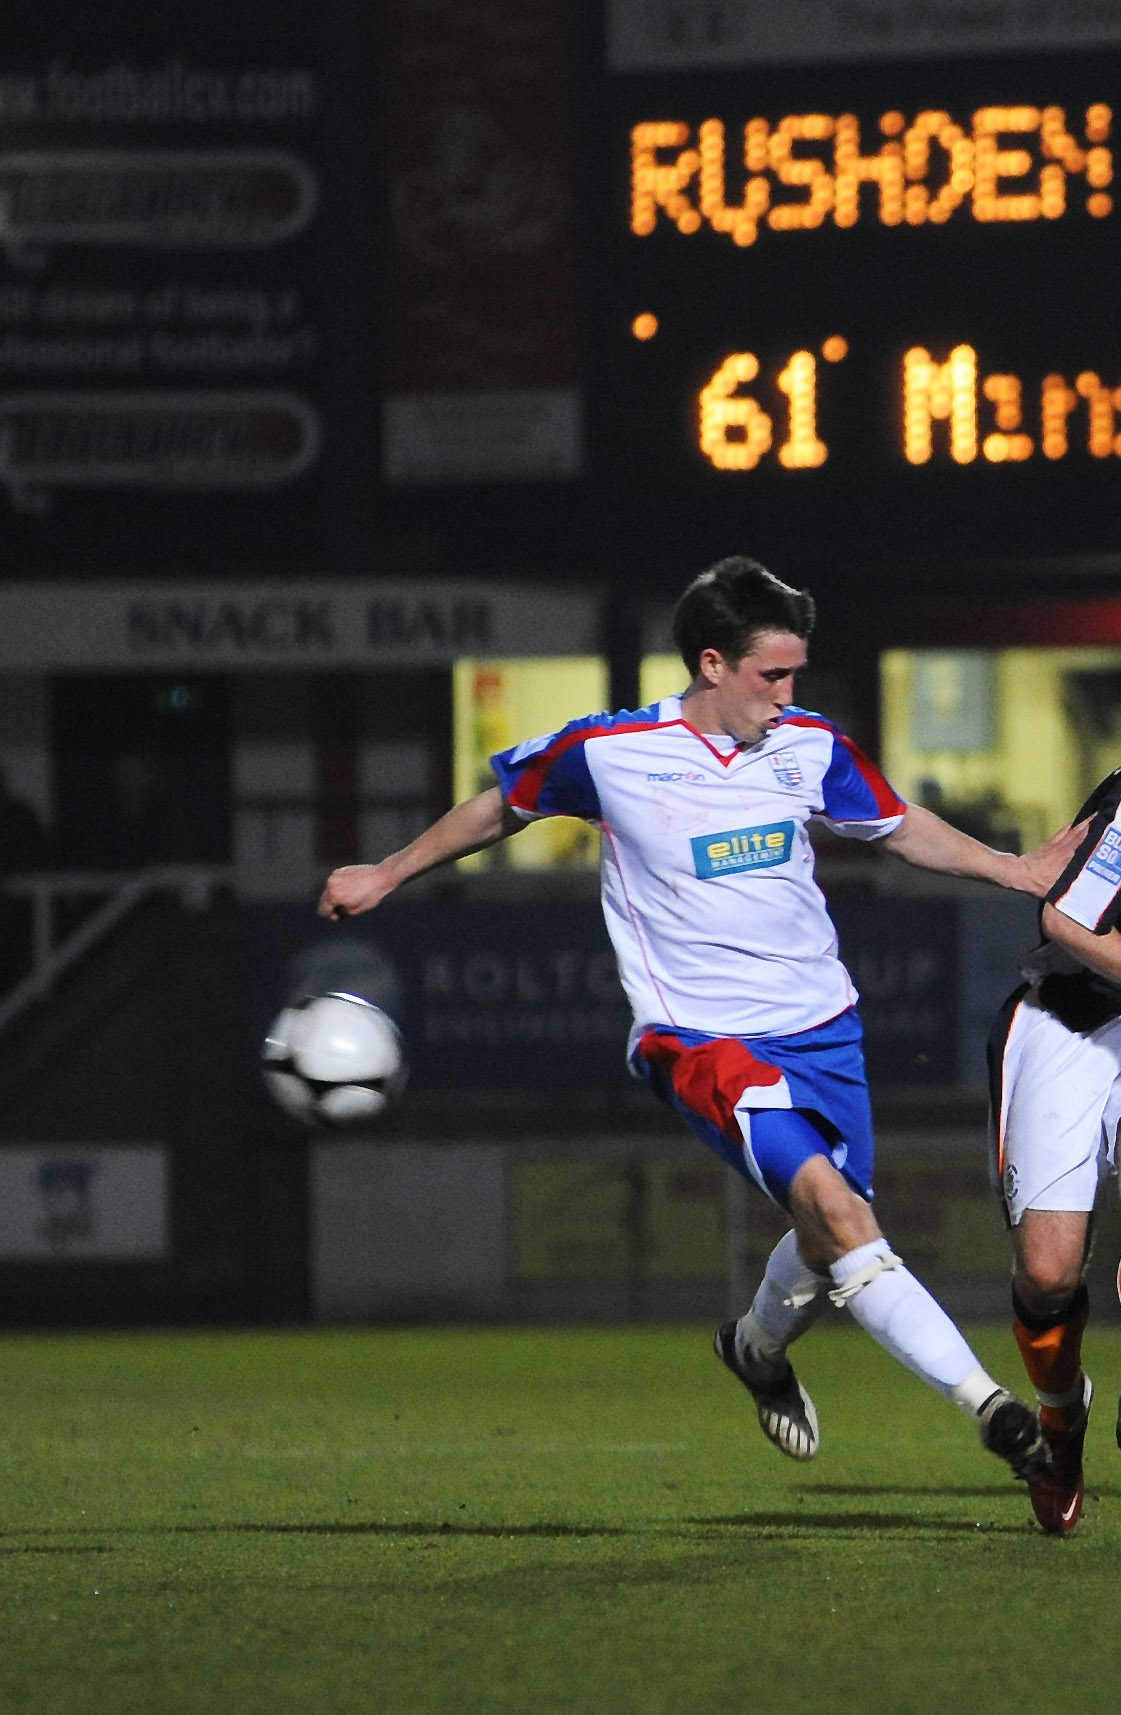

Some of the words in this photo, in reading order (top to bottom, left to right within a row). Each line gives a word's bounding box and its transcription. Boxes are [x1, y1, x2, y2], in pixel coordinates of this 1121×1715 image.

[631, 104, 1113, 247] RUSHDEN
[698, 350, 829, 471] 61
[126, 597, 334, 652] SNACK
[366, 597, 496, 651] BAR
[707, 832, 785, 859] elite
[422, 948, 623, 1003] ROLTO
